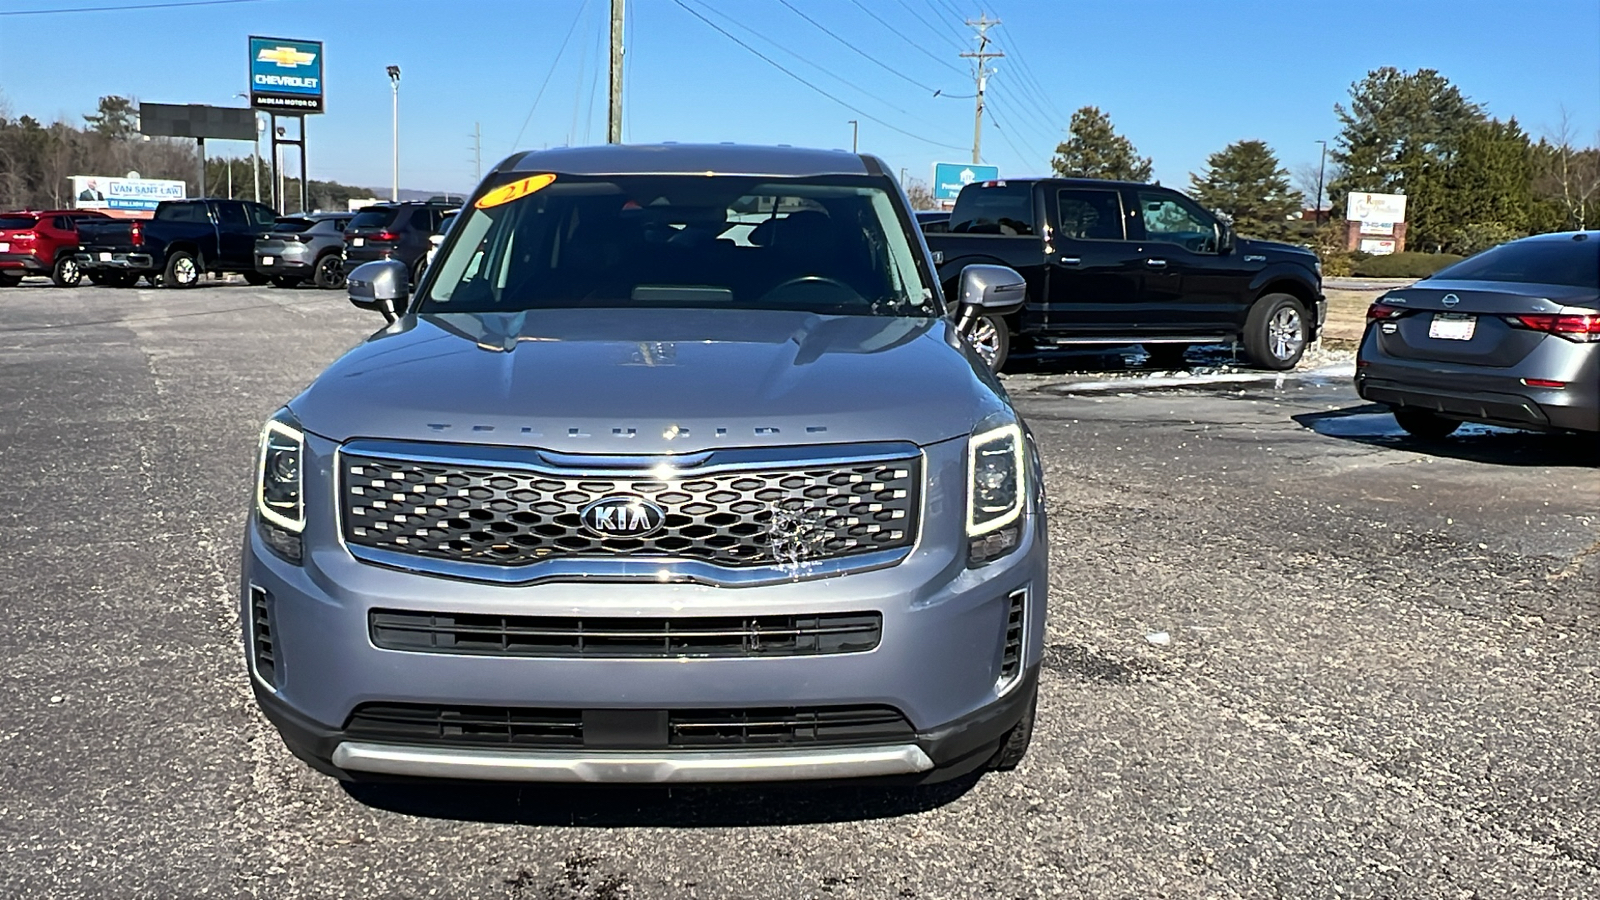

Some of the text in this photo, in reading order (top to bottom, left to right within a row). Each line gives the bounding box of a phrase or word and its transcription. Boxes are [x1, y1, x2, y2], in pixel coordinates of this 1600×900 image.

[255, 75, 318, 88] CHEVROLET
[113, 184, 180, 195] VAN SANT LAW
[503, 180, 530, 200] 21
[427, 423, 827, 439] TELLURIDE
[594, 506, 651, 530] KIA
